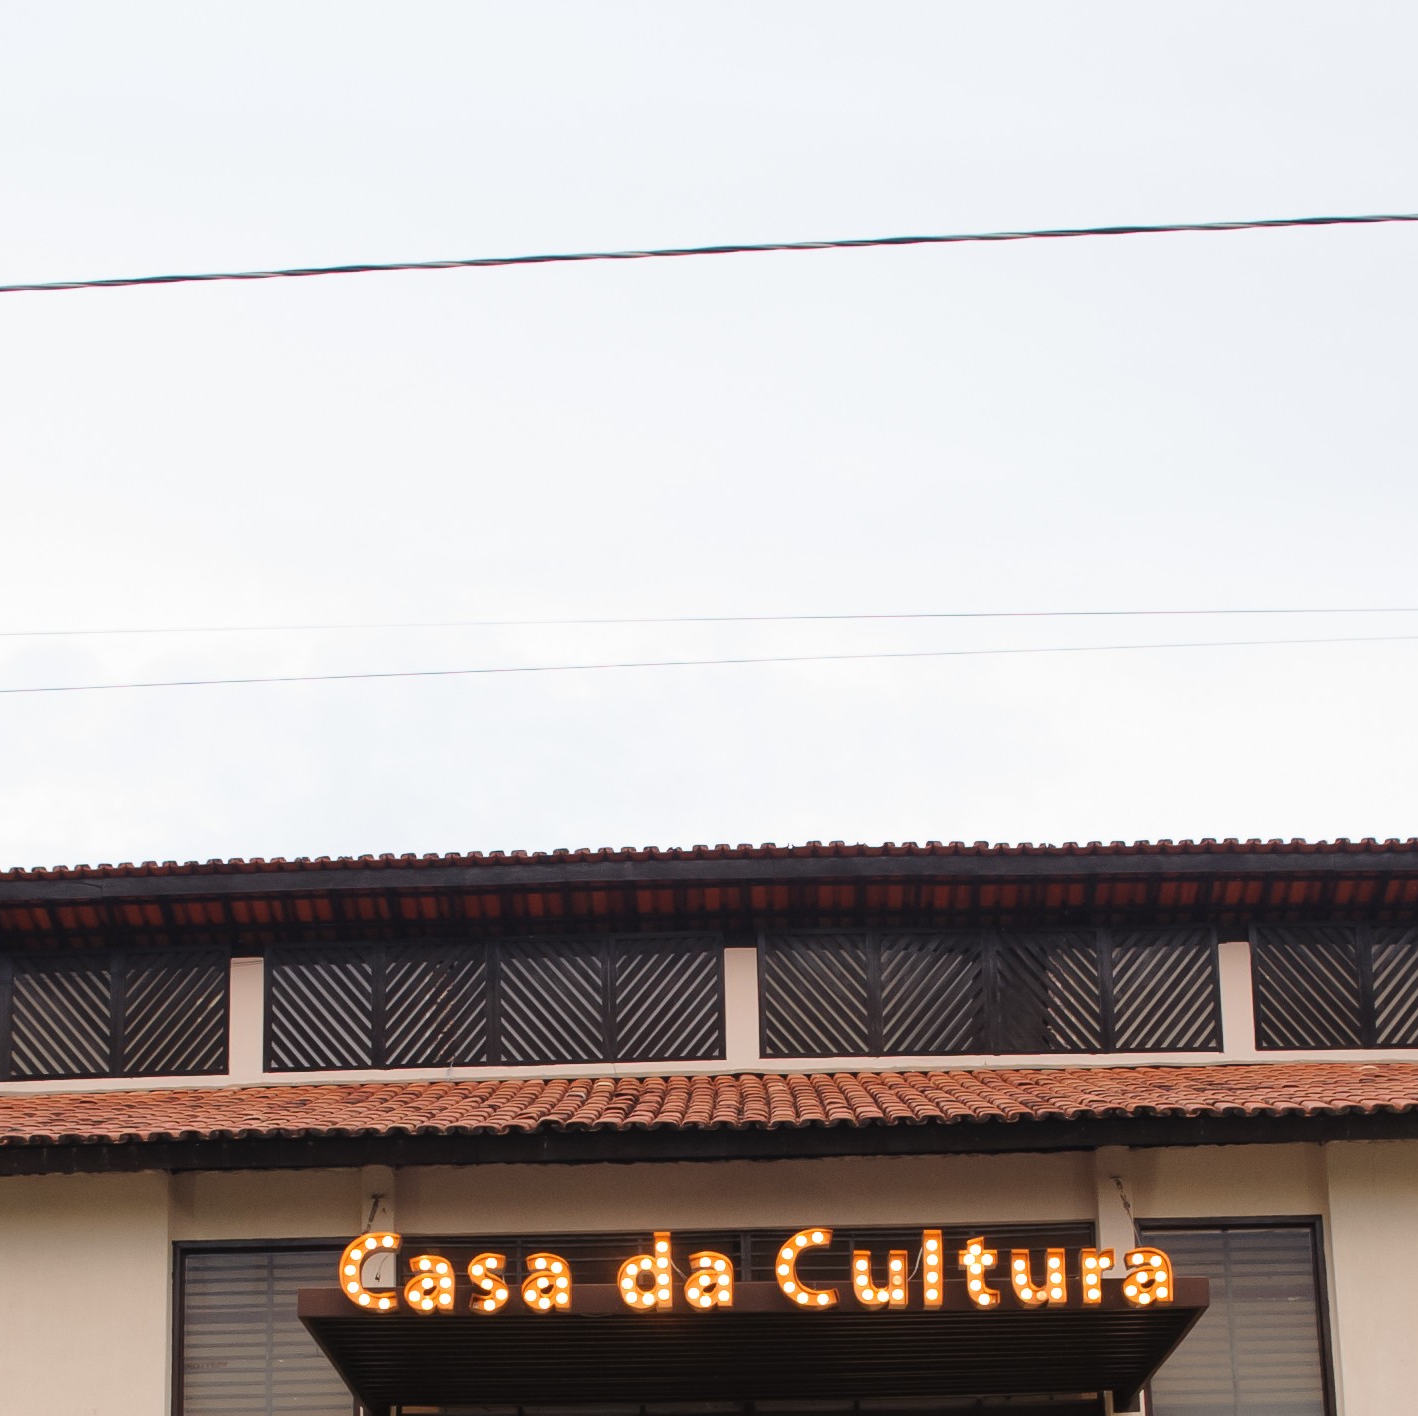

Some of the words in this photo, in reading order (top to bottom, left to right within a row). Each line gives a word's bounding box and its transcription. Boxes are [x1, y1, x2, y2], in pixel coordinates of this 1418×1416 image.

[339, 1232, 572, 1313] Casa
[617, 1232, 733, 1312] da
[776, 1228, 1174, 1311] Cultura
